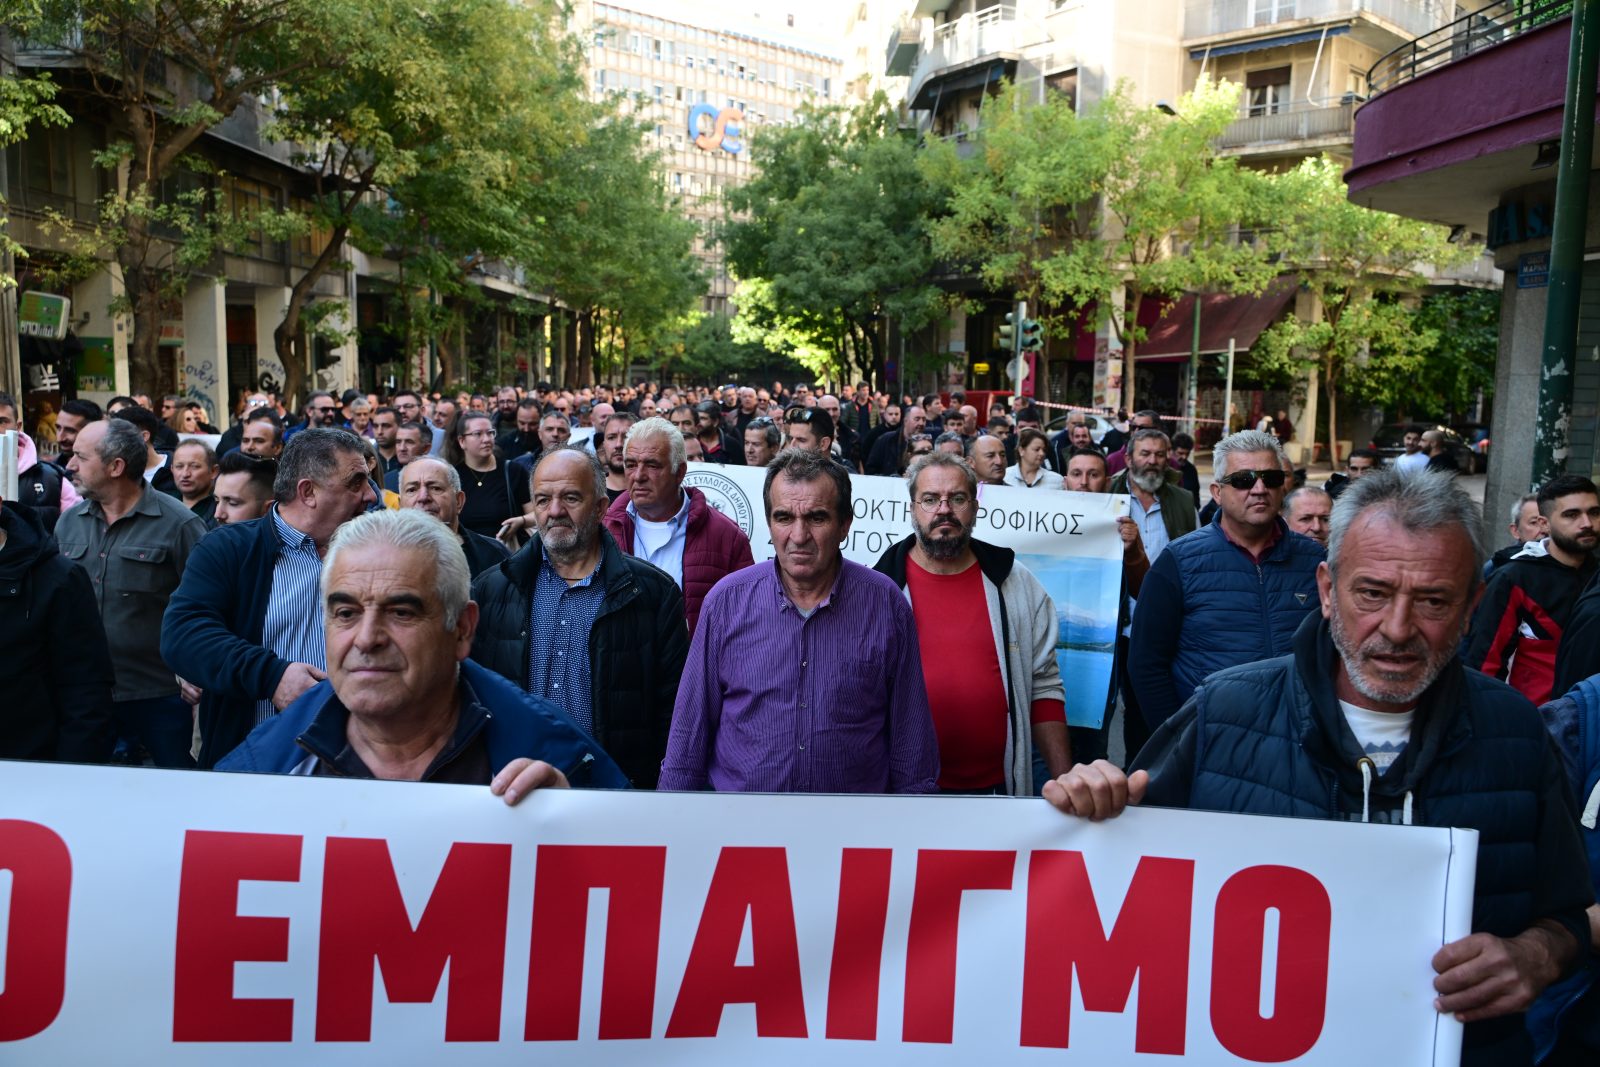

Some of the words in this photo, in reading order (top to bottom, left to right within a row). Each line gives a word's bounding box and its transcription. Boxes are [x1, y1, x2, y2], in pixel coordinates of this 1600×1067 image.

[730, 491, 747, 519] ΔΗΜΟΥ
[976, 507, 1084, 535] ΡΟΦΙΚΟΣ
[172, 829, 1332, 1063] ΕΜΠΑΙΓΜΟ
